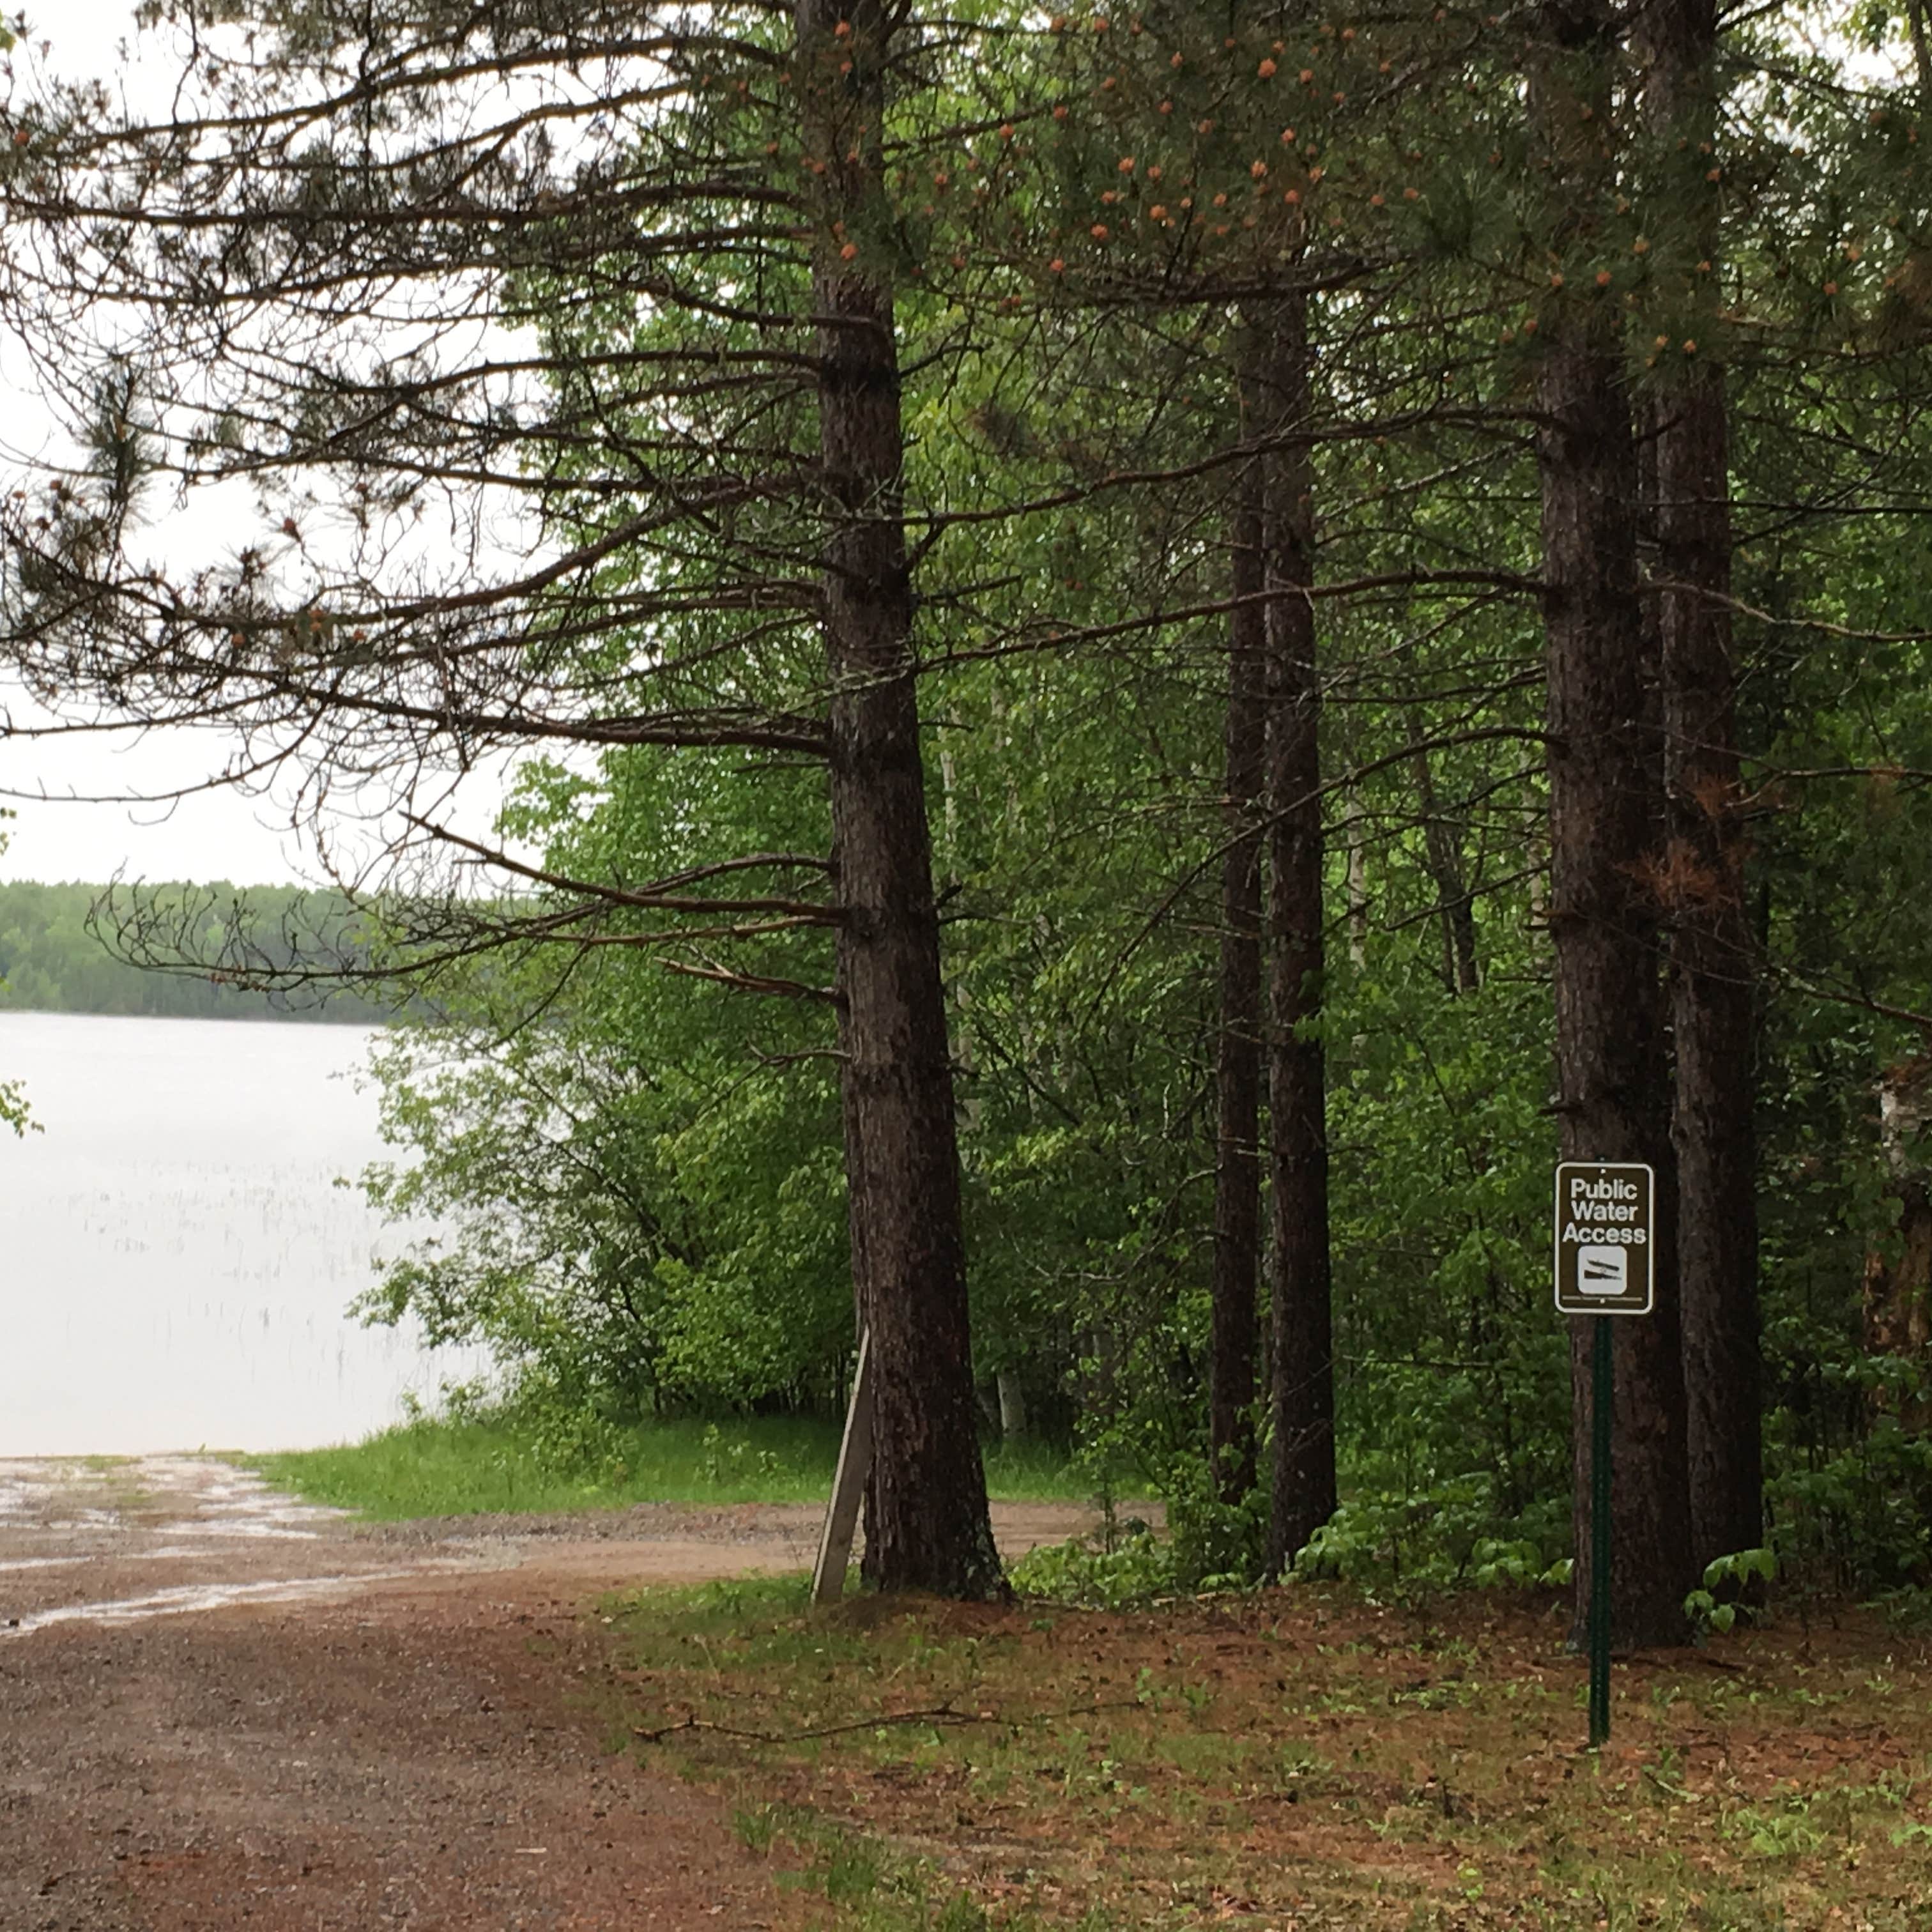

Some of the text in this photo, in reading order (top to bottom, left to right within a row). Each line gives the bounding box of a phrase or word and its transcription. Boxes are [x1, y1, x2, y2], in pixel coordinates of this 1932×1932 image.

[1570, 1178, 1637, 1200] Public
[1571, 1200, 1638, 1221] Water
[1562, 1222, 1646, 1244] Access
